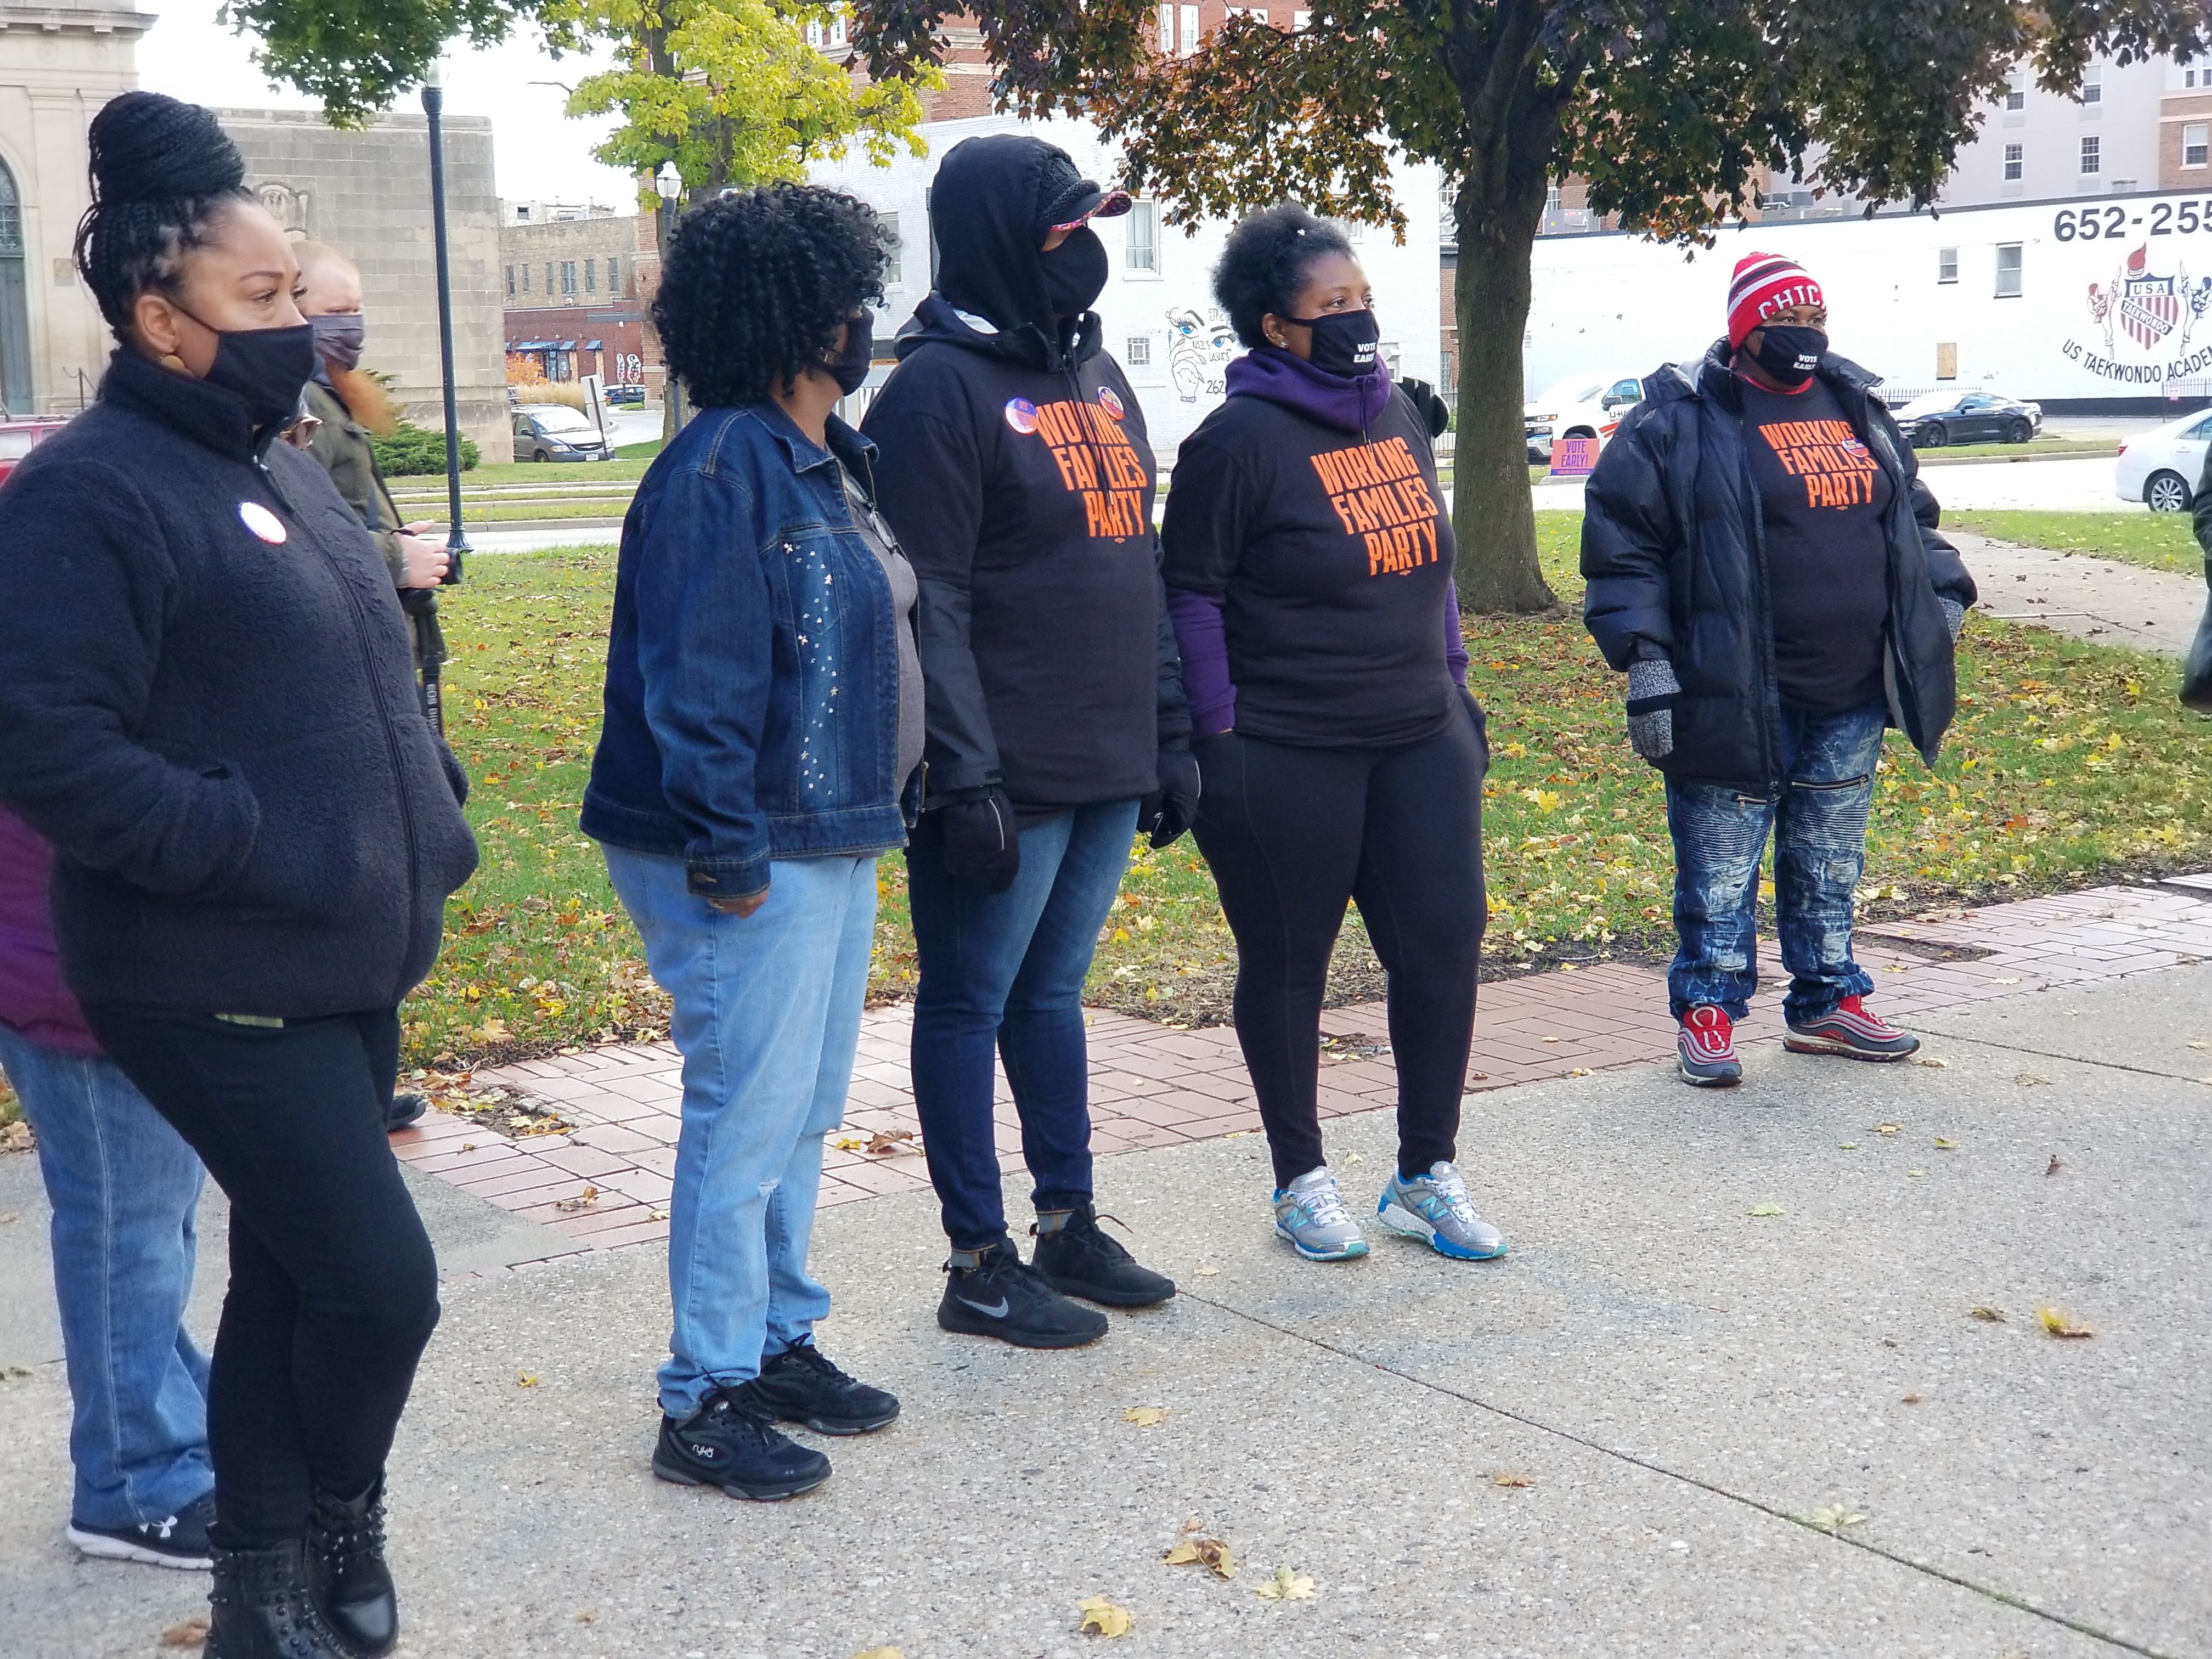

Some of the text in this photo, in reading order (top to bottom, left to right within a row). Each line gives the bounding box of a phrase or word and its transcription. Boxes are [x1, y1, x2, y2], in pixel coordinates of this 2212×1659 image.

[2121, 301, 2169, 334] TAEKWONDO
[1192, 340, 1210, 350] NAILS
[1357, 342, 1376, 353] VOTE
[1798, 354, 1818, 363] VOTE
[2062, 338, 2082, 362] U.S.
[2083, 352, 2162, 383] TAEKWONDO
[1206, 379, 1226, 395] 262
[1566, 441, 1587, 453] VOTE
[1758, 420, 1856, 450] WORKING
[1310, 436, 1420, 496] WORKING
[1561, 454, 1589, 467] EARLY!
[1804, 470, 1873, 509] PARTY
[1331, 476, 1439, 535] FAMILIES
[1363, 518, 1438, 576] PARTY
